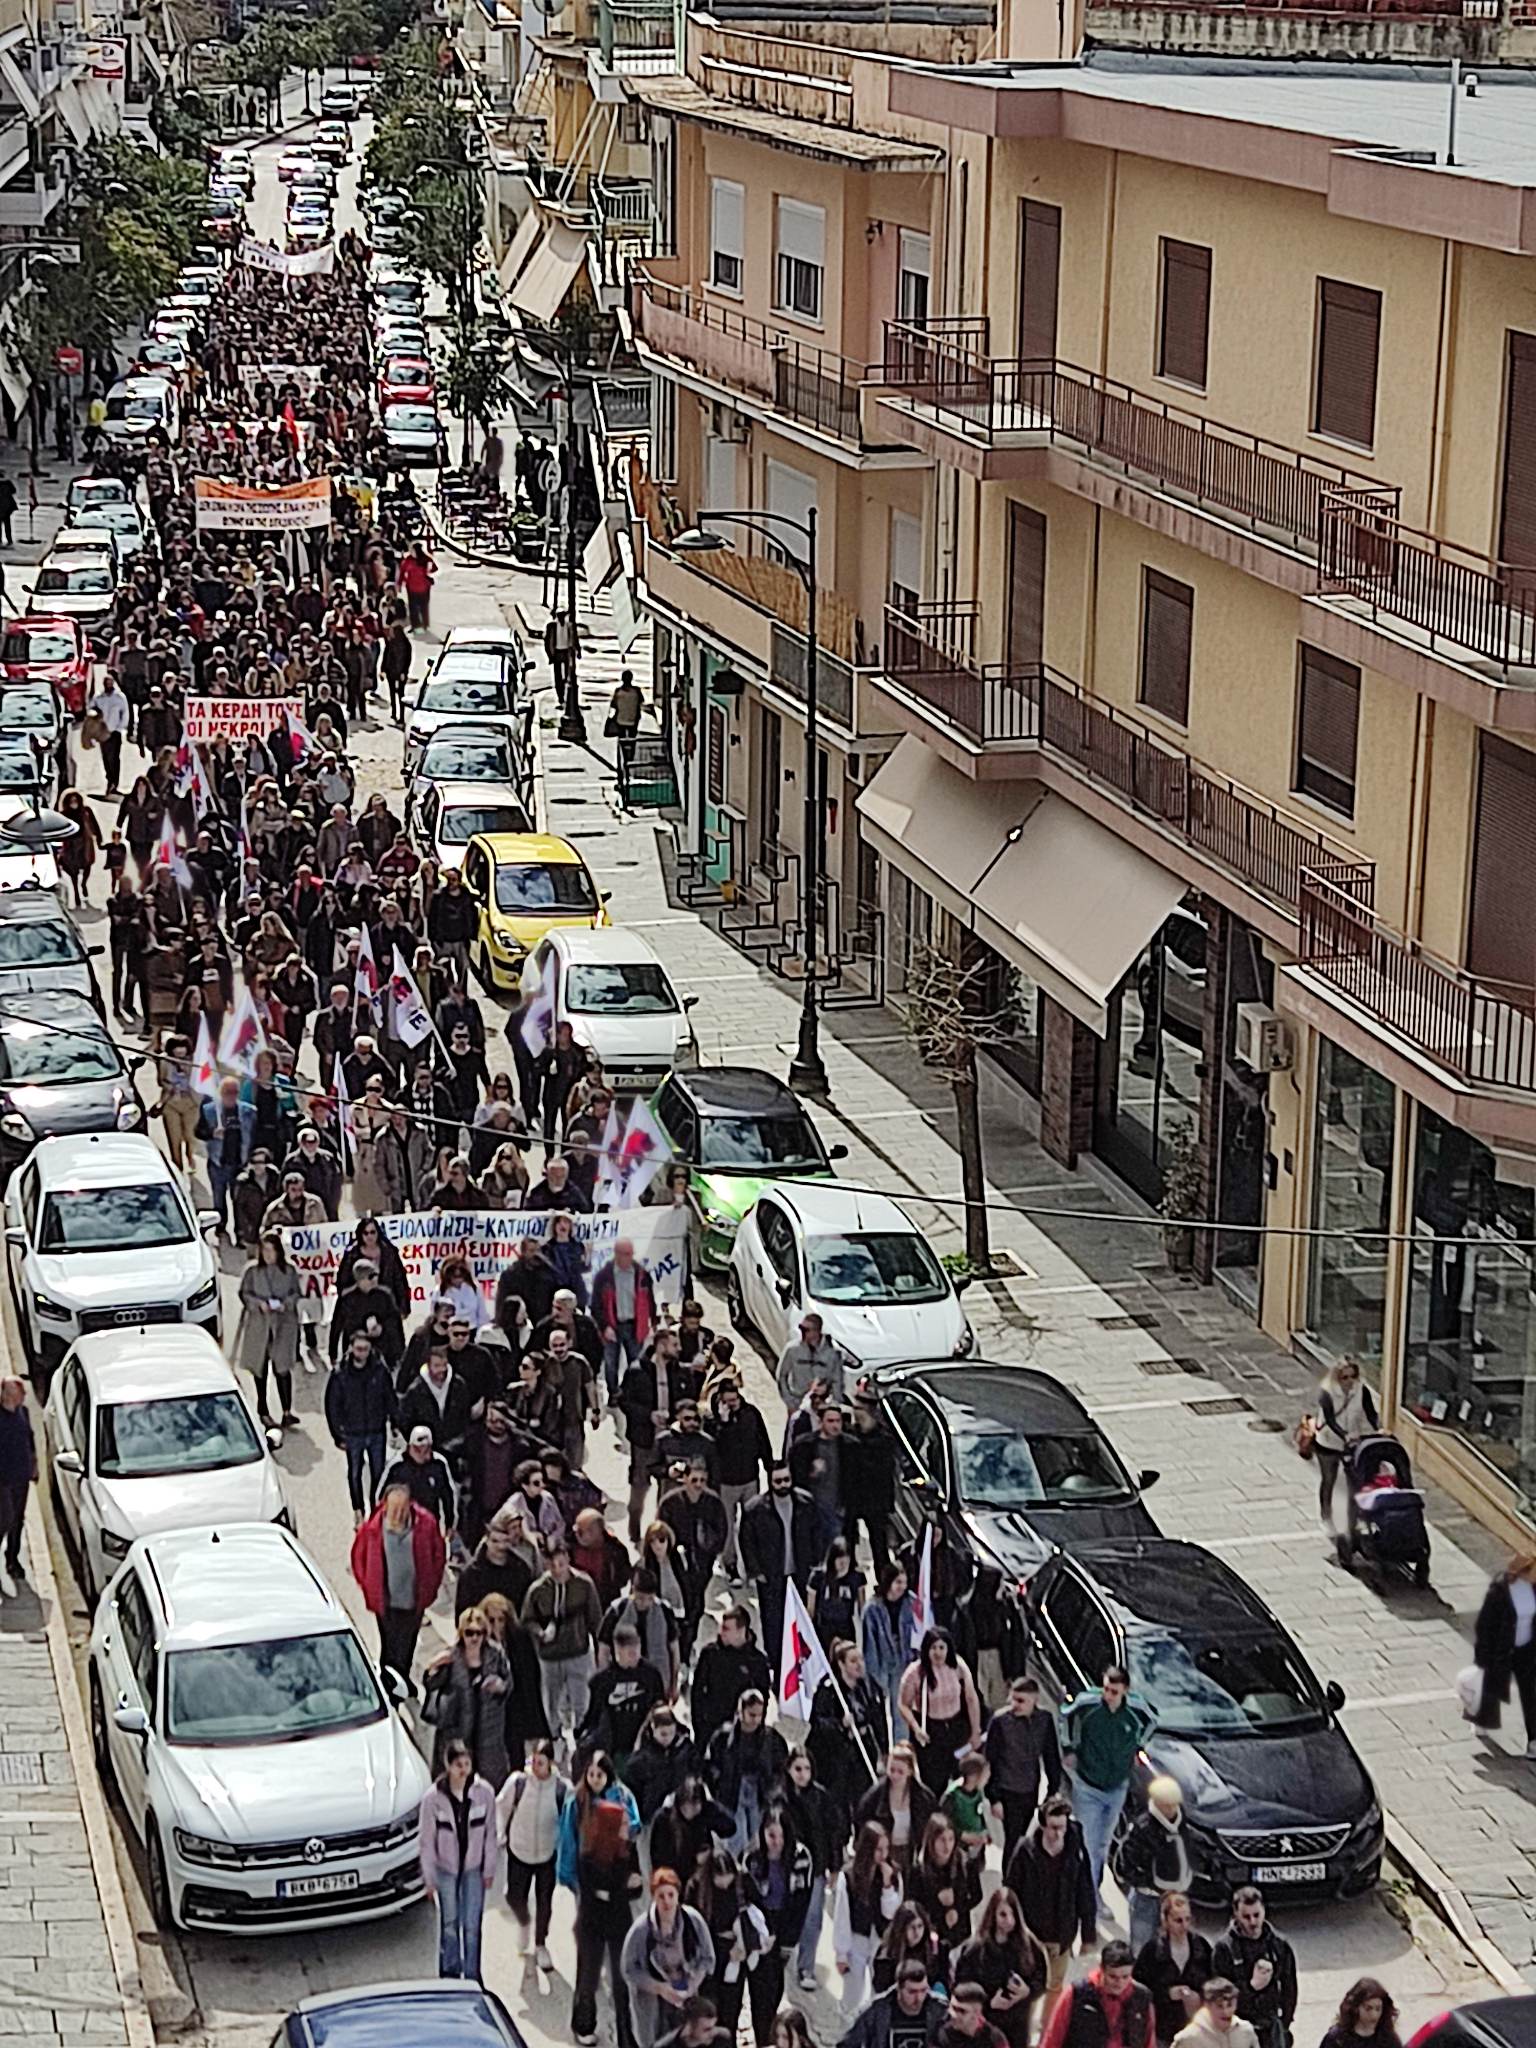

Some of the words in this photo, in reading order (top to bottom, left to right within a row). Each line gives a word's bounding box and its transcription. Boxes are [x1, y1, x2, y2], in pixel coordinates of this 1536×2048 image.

[187, 702, 205, 719] ΤΑ
[211, 703, 261, 719] ΚΕΡΔΗ
[187, 721, 202, 737] ΟΙ
[291, 1230, 320, 1251] ΟΧΙ
